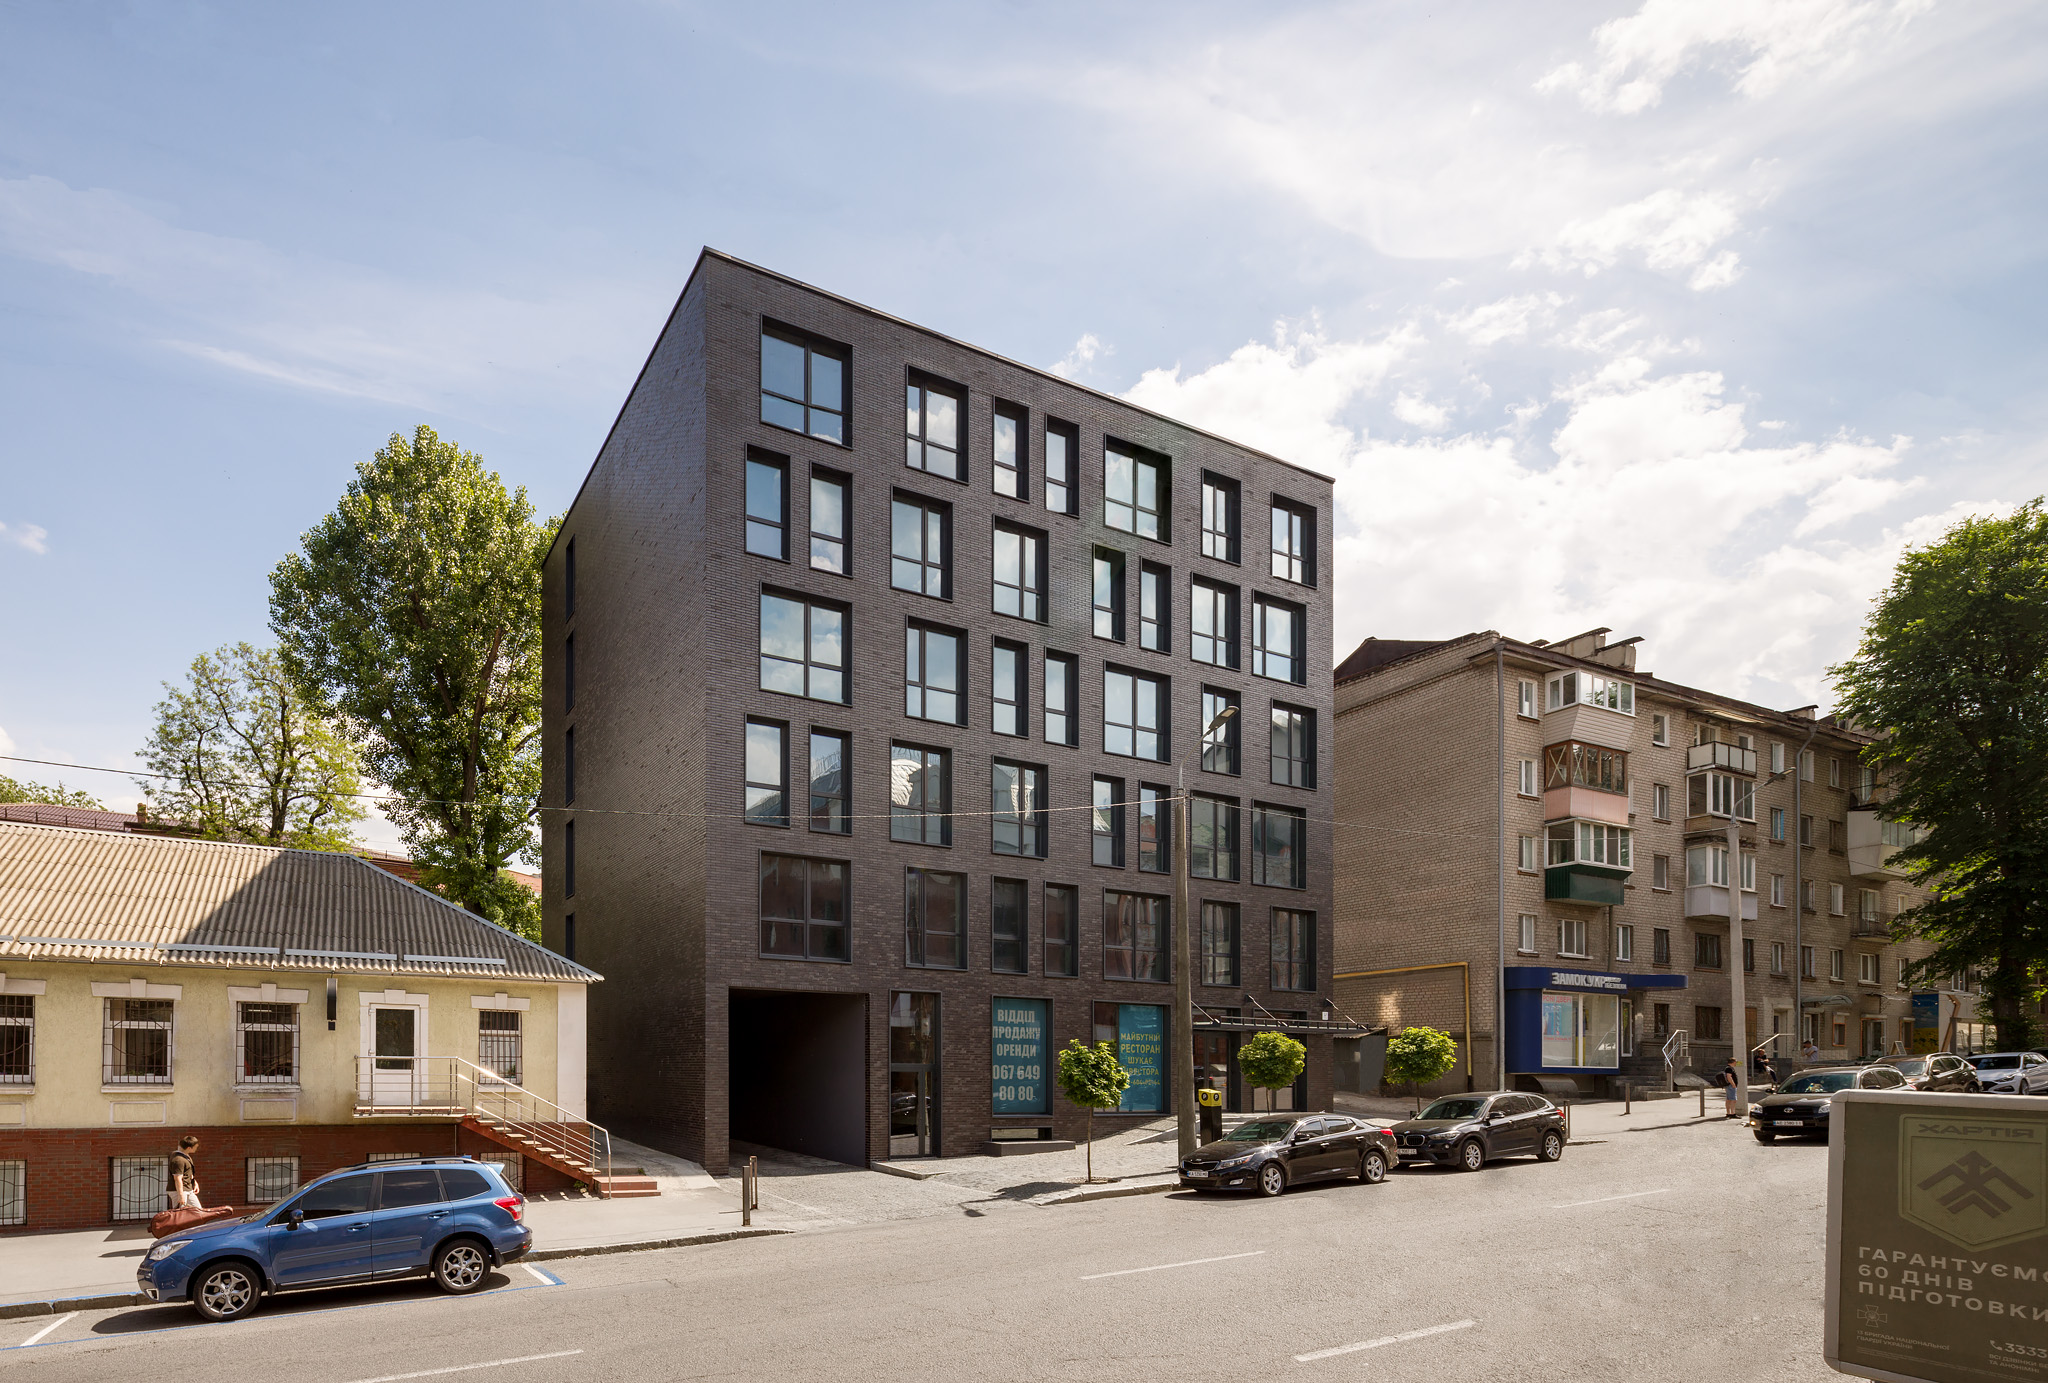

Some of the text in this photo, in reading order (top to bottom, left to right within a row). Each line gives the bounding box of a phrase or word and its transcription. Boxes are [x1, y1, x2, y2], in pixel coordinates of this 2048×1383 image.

[997, 1008, 1036, 1024] ВІДДІЛ
[1120, 1031, 1161, 1042] МАЙБУТНІЙ
[996, 1043, 1037, 1059] ОРЕНДИ
[1120, 1043, 1161, 1054] РЕСТОРАН
[1127, 1056, 1153, 1065] ШУКАЄ
[992, 1064, 1041, 1080] 067 649
[1122, 1067, 1160, 1076] НВЕСТОРА
[1017, 1085, 1034, 1101] 80
[1918, 1123, 2035, 1139] ХАРТІЯ
[1858, 1264, 1974, 1292] 60 ДНІВ
[1858, 1281, 2048, 1323] ПІДГОТОВКИ
[1856, 1335, 1913, 1350] ГВАРДІЇ УКРАЇНИ
[1864, 1331, 1895, 1341] БРИГАДА
[1896, 1337, 1950, 1351] НАЦІОНАЛЬНОЇ
[1999, 1361, 2040, 1374] АНОНІМНІ
[2002, 1356, 2037, 1367] ДЗВІНКИ
